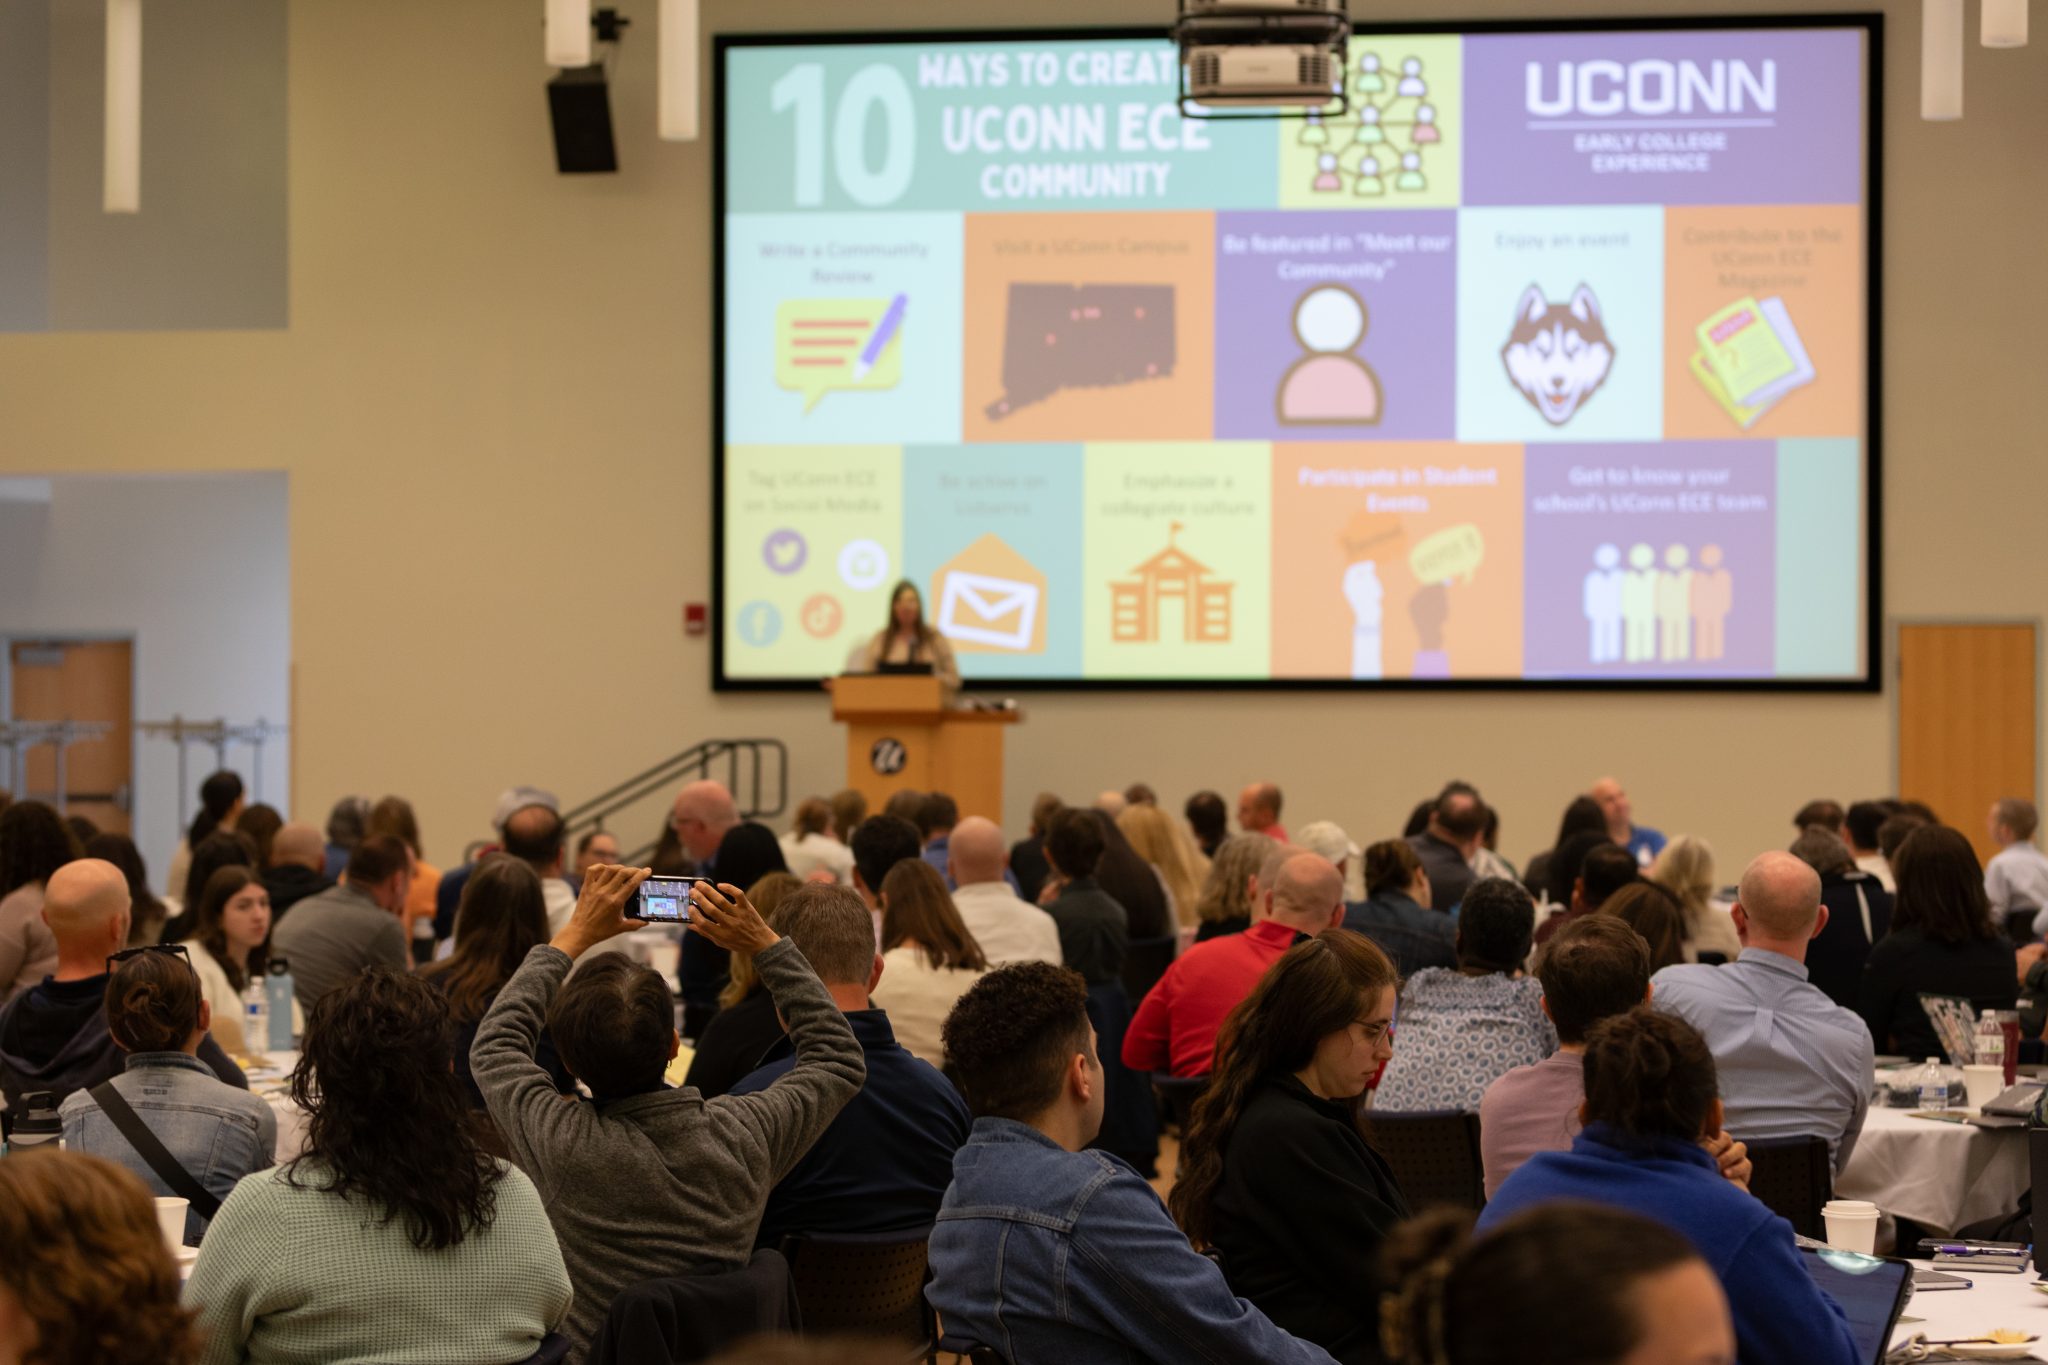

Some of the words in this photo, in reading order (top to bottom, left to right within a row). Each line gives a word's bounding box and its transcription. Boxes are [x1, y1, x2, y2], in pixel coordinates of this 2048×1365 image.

[919, 52, 1008, 88] WAYS
[1016, 52, 1059, 87] TO
[1066, 50, 1190, 86] CREAT
[1525, 59, 1777, 116] UCONN
[771, 63, 916, 206] 10
[942, 103, 1105, 154] UCONN
[1117, 101, 1211, 151] ECE
[1573, 132, 1632, 152] EARLY
[1637, 130, 1728, 151] COLLEGE
[1591, 152, 1710, 173] EXPERIENCE
[980, 161, 1171, 199] COMMUNITY
[1222, 234, 1248, 254] Be
[1250, 233, 1328, 254] featured
[1331, 234, 1352, 253] in
[1417, 234, 1451, 253] our
[1568, 465, 1604, 486] Get
[1605, 467, 1629, 486] to
[1631, 465, 1684, 486] know
[1685, 468, 1731, 488] your
[1715, 494, 1769, 513] team
